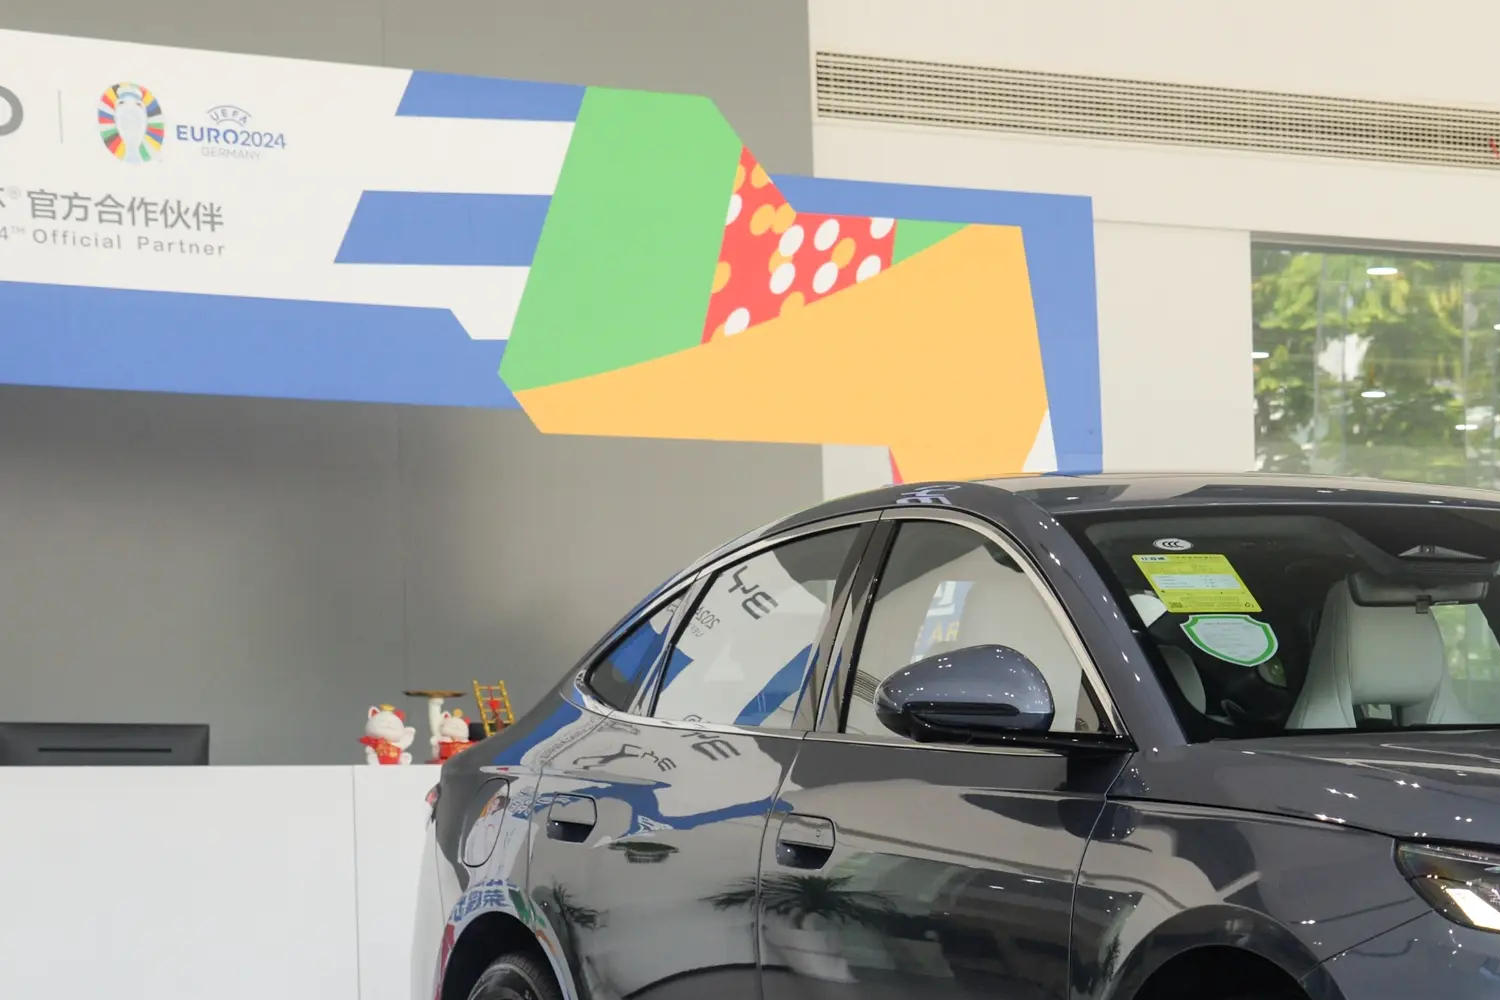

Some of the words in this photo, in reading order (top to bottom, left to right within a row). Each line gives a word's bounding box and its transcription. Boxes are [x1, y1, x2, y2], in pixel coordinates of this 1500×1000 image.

[176, 124, 287, 150] EURO2024
[26, 188, 225, 233] 官方合作伙伴
[32, 227, 122, 250] Official
[136, 235, 226, 257] Partner
